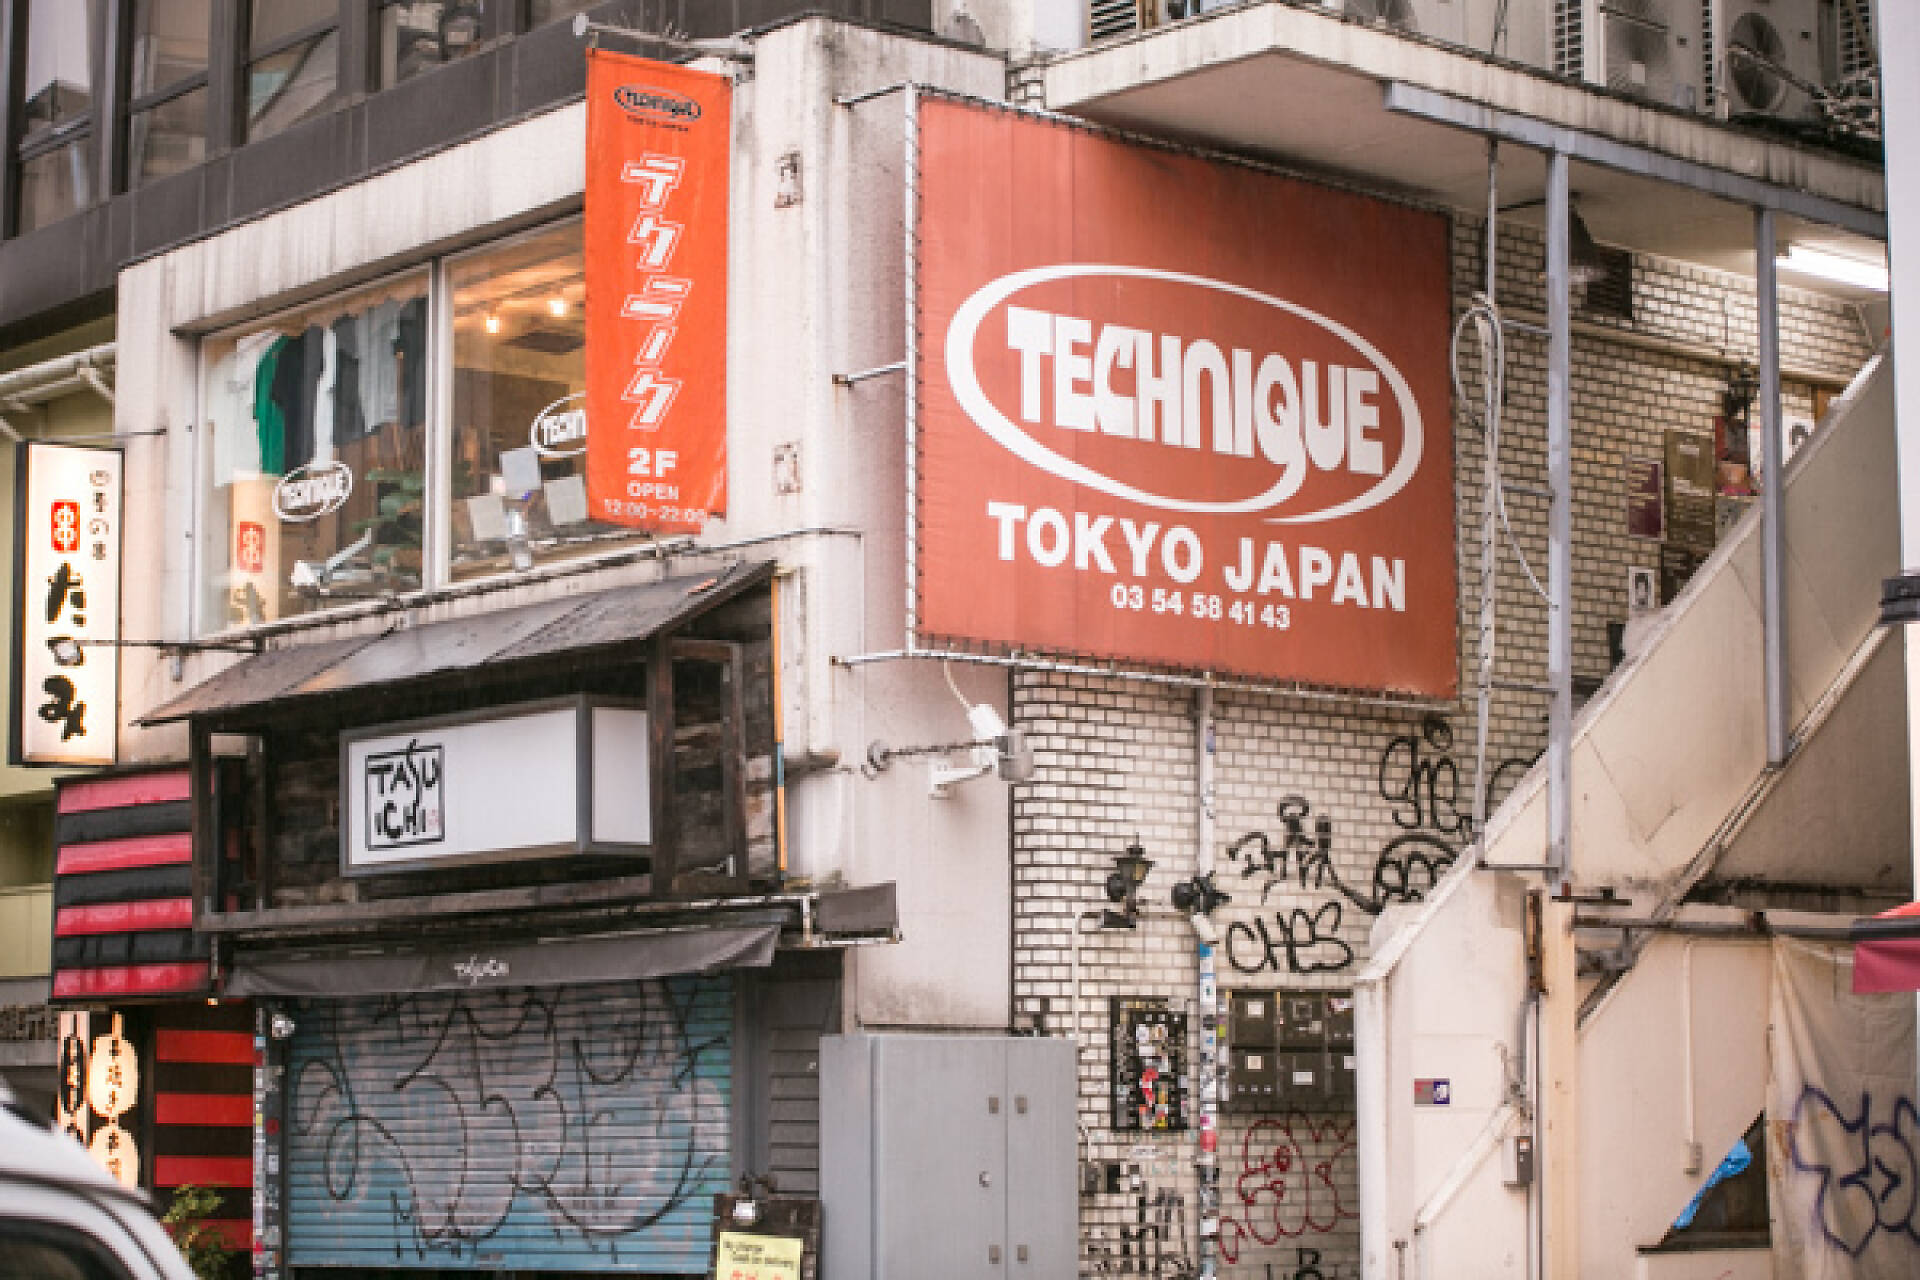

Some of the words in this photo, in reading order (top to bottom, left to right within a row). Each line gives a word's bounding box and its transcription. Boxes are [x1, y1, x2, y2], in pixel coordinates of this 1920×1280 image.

[1007, 304, 1386, 477] TECHNIQUE
[627, 448, 679, 478] 2F
[627, 480, 679, 500] OPEN
[987, 501, 1202, 583] TOKYO
[1223, 537, 1406, 611] JAPAN
[1112, 583, 1144, 610] 03
[1151, 588, 1184, 615] 54
[1191, 593, 1223, 621] 58
[1229, 599, 1256, 626] 41
[1260, 604, 1291, 631] 43
